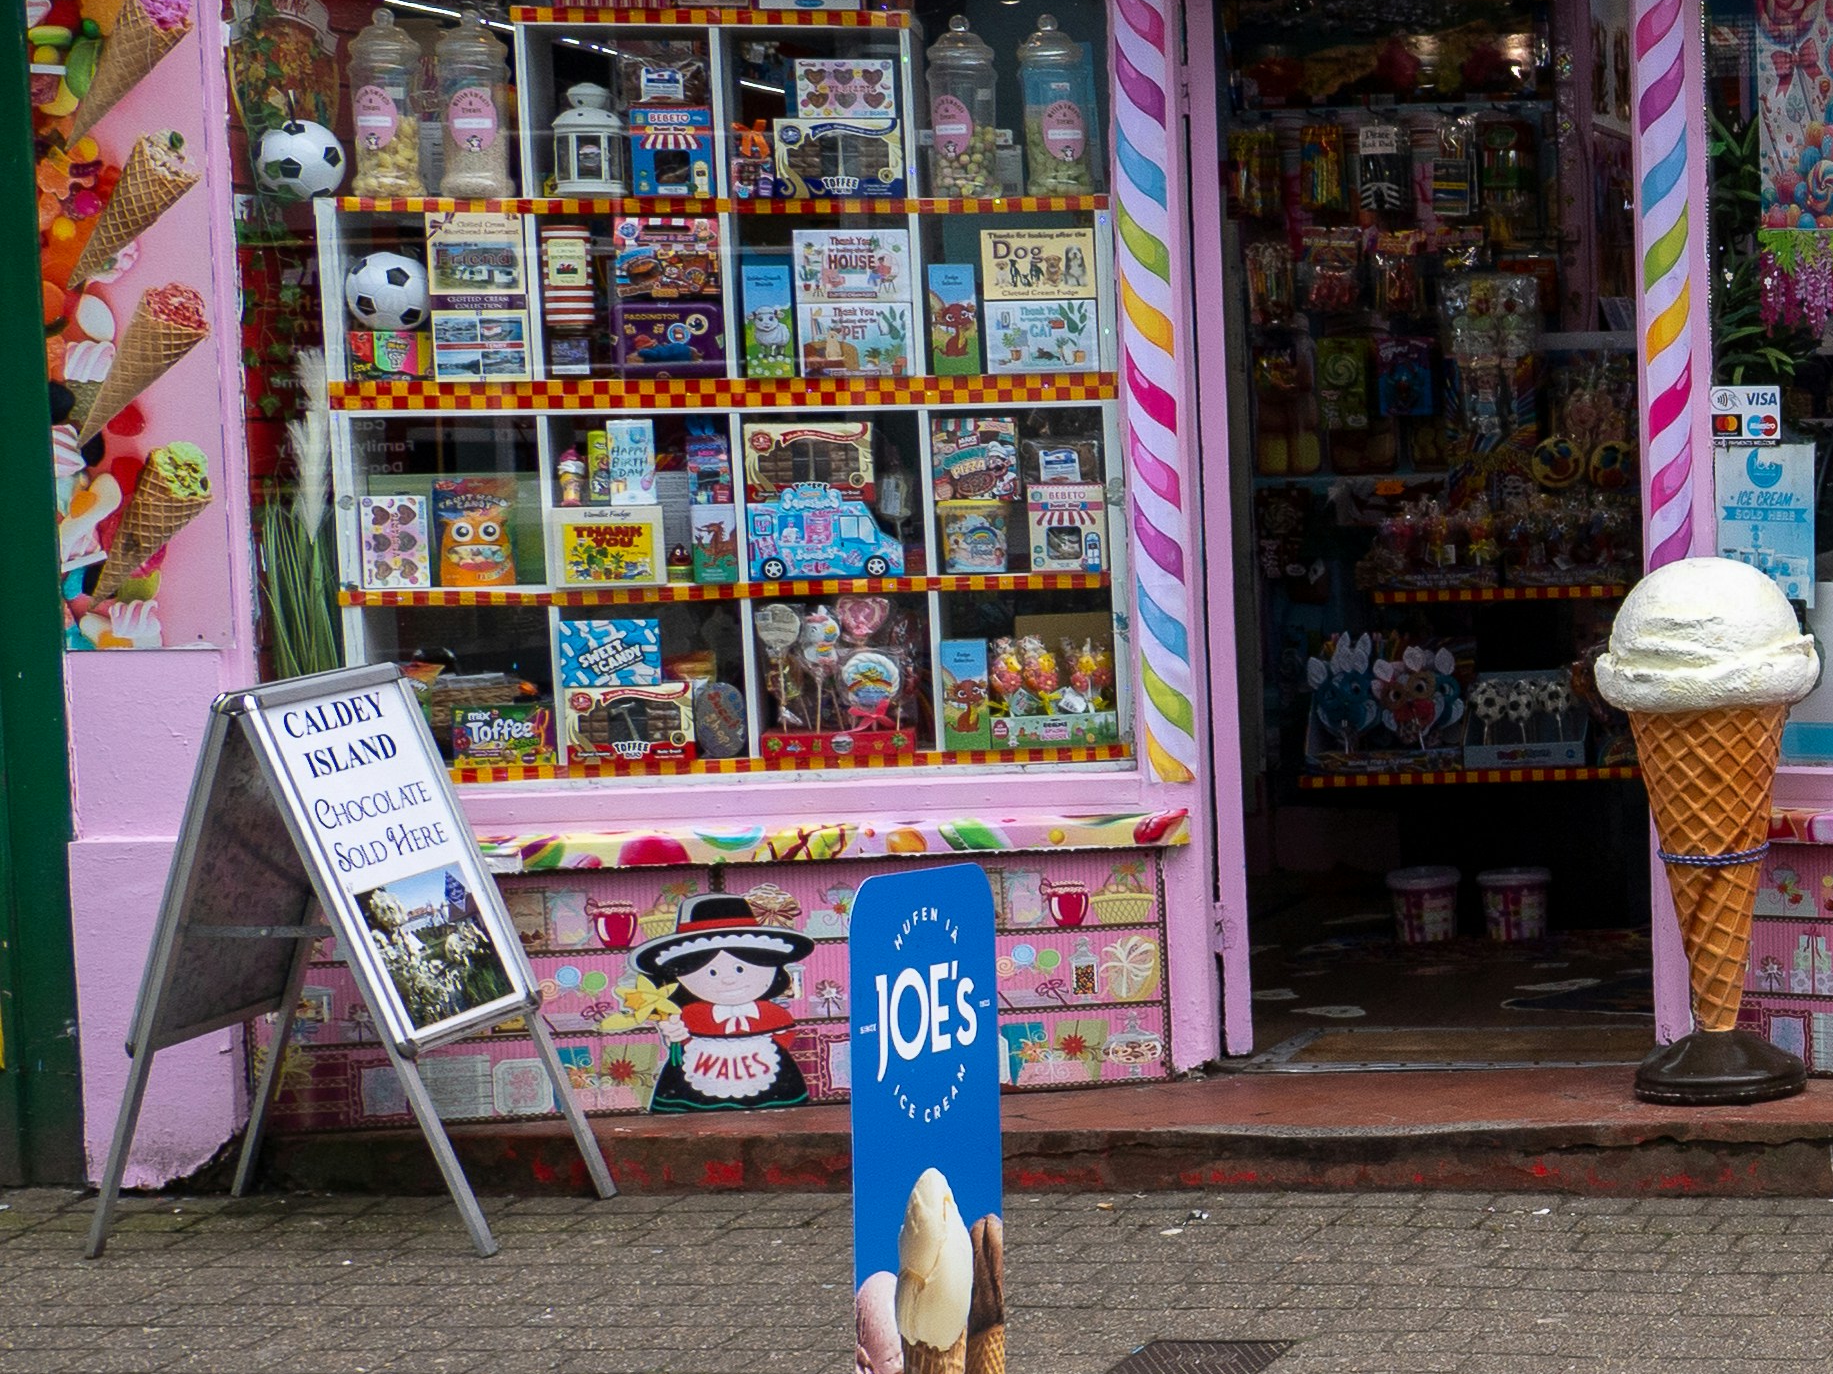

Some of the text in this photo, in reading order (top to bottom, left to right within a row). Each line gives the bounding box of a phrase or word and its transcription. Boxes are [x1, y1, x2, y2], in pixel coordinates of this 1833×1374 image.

[648, 113, 690, 123] BEBETO
[822, 177, 859, 188] TOFFEE
[830, 236, 855, 245] Thank
[1028, 232, 1053, 240] looking
[436, 249, 512, 266] Friend
[992, 240, 1044, 263] Dog
[828, 255, 876, 270] HOUSE
[833, 307, 874, 317] Thank You
[1020, 307, 1045, 316] Thank
[841, 326, 867, 340] PET
[1746, 393, 1777, 405] VISA
[612, 446, 647, 456] HAPPY
[612, 457, 647, 468] BIRTH
[951, 459, 984, 477] PIZZA
[619, 468, 644, 477] DAY
[1737, 491, 1793, 506] ICE CREAM
[1735, 510, 1796, 522] SOLD HERE
[574, 526, 643, 538] THANK
[593, 537, 634, 548] YOU
[578, 639, 624, 668] SWEET
[597, 645, 643, 673] CANDY
[282, 693, 385, 739] CALDEY
[467, 710, 490, 721] mix
[468, 719, 536, 743] Toffee
[614, 742, 650, 753] TOFFEE
[303, 734, 398, 779] ISLAND
[314, 782, 433, 831] CHOCOLATE
[334, 822, 449, 873] SOLD HERE
[894, 907, 938, 951] HUFEN
[875, 960, 977, 1083] JOE'S
[692, 1050, 771, 1083] WALES
[894, 1063, 966, 1124] ICE CREAM
